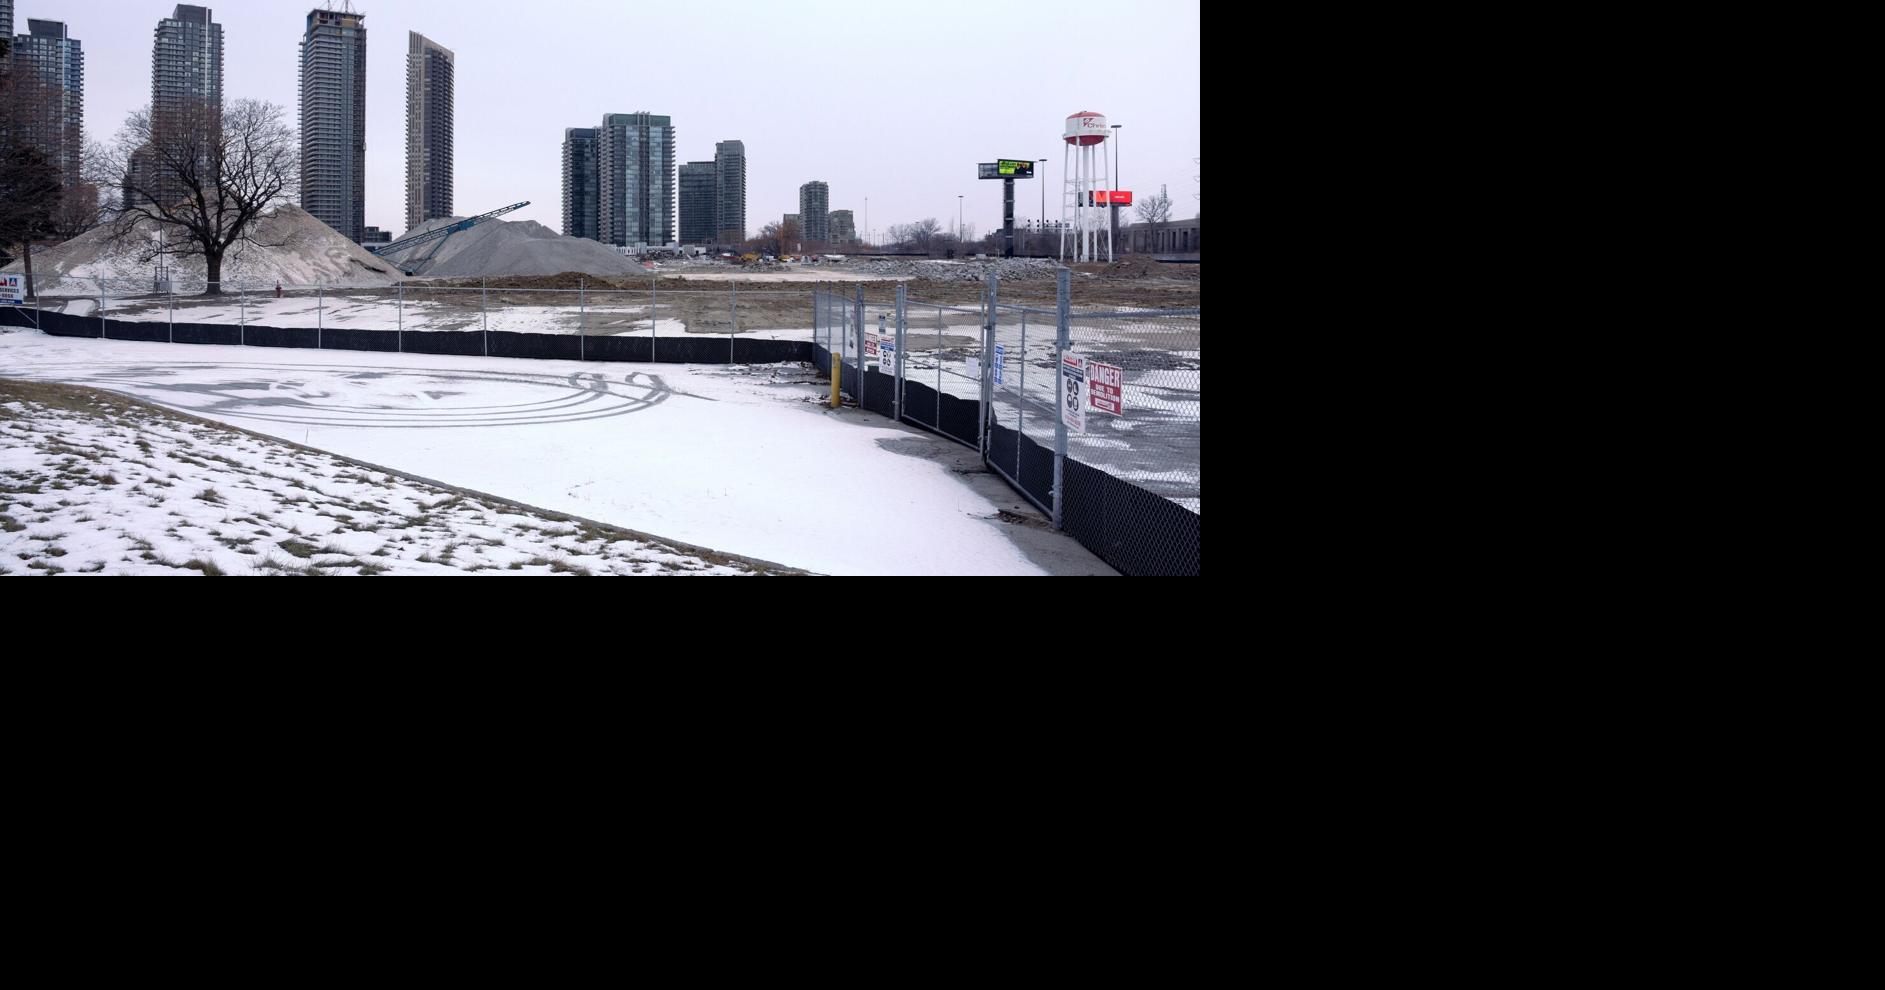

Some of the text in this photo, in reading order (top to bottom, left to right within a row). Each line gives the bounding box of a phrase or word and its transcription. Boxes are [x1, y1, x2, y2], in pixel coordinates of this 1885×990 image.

[1090, 363, 1120, 388] DANGER
[1090, 388, 1120, 403] DEMOLITION
[1095, 384, 1114, 395] DUE TO
